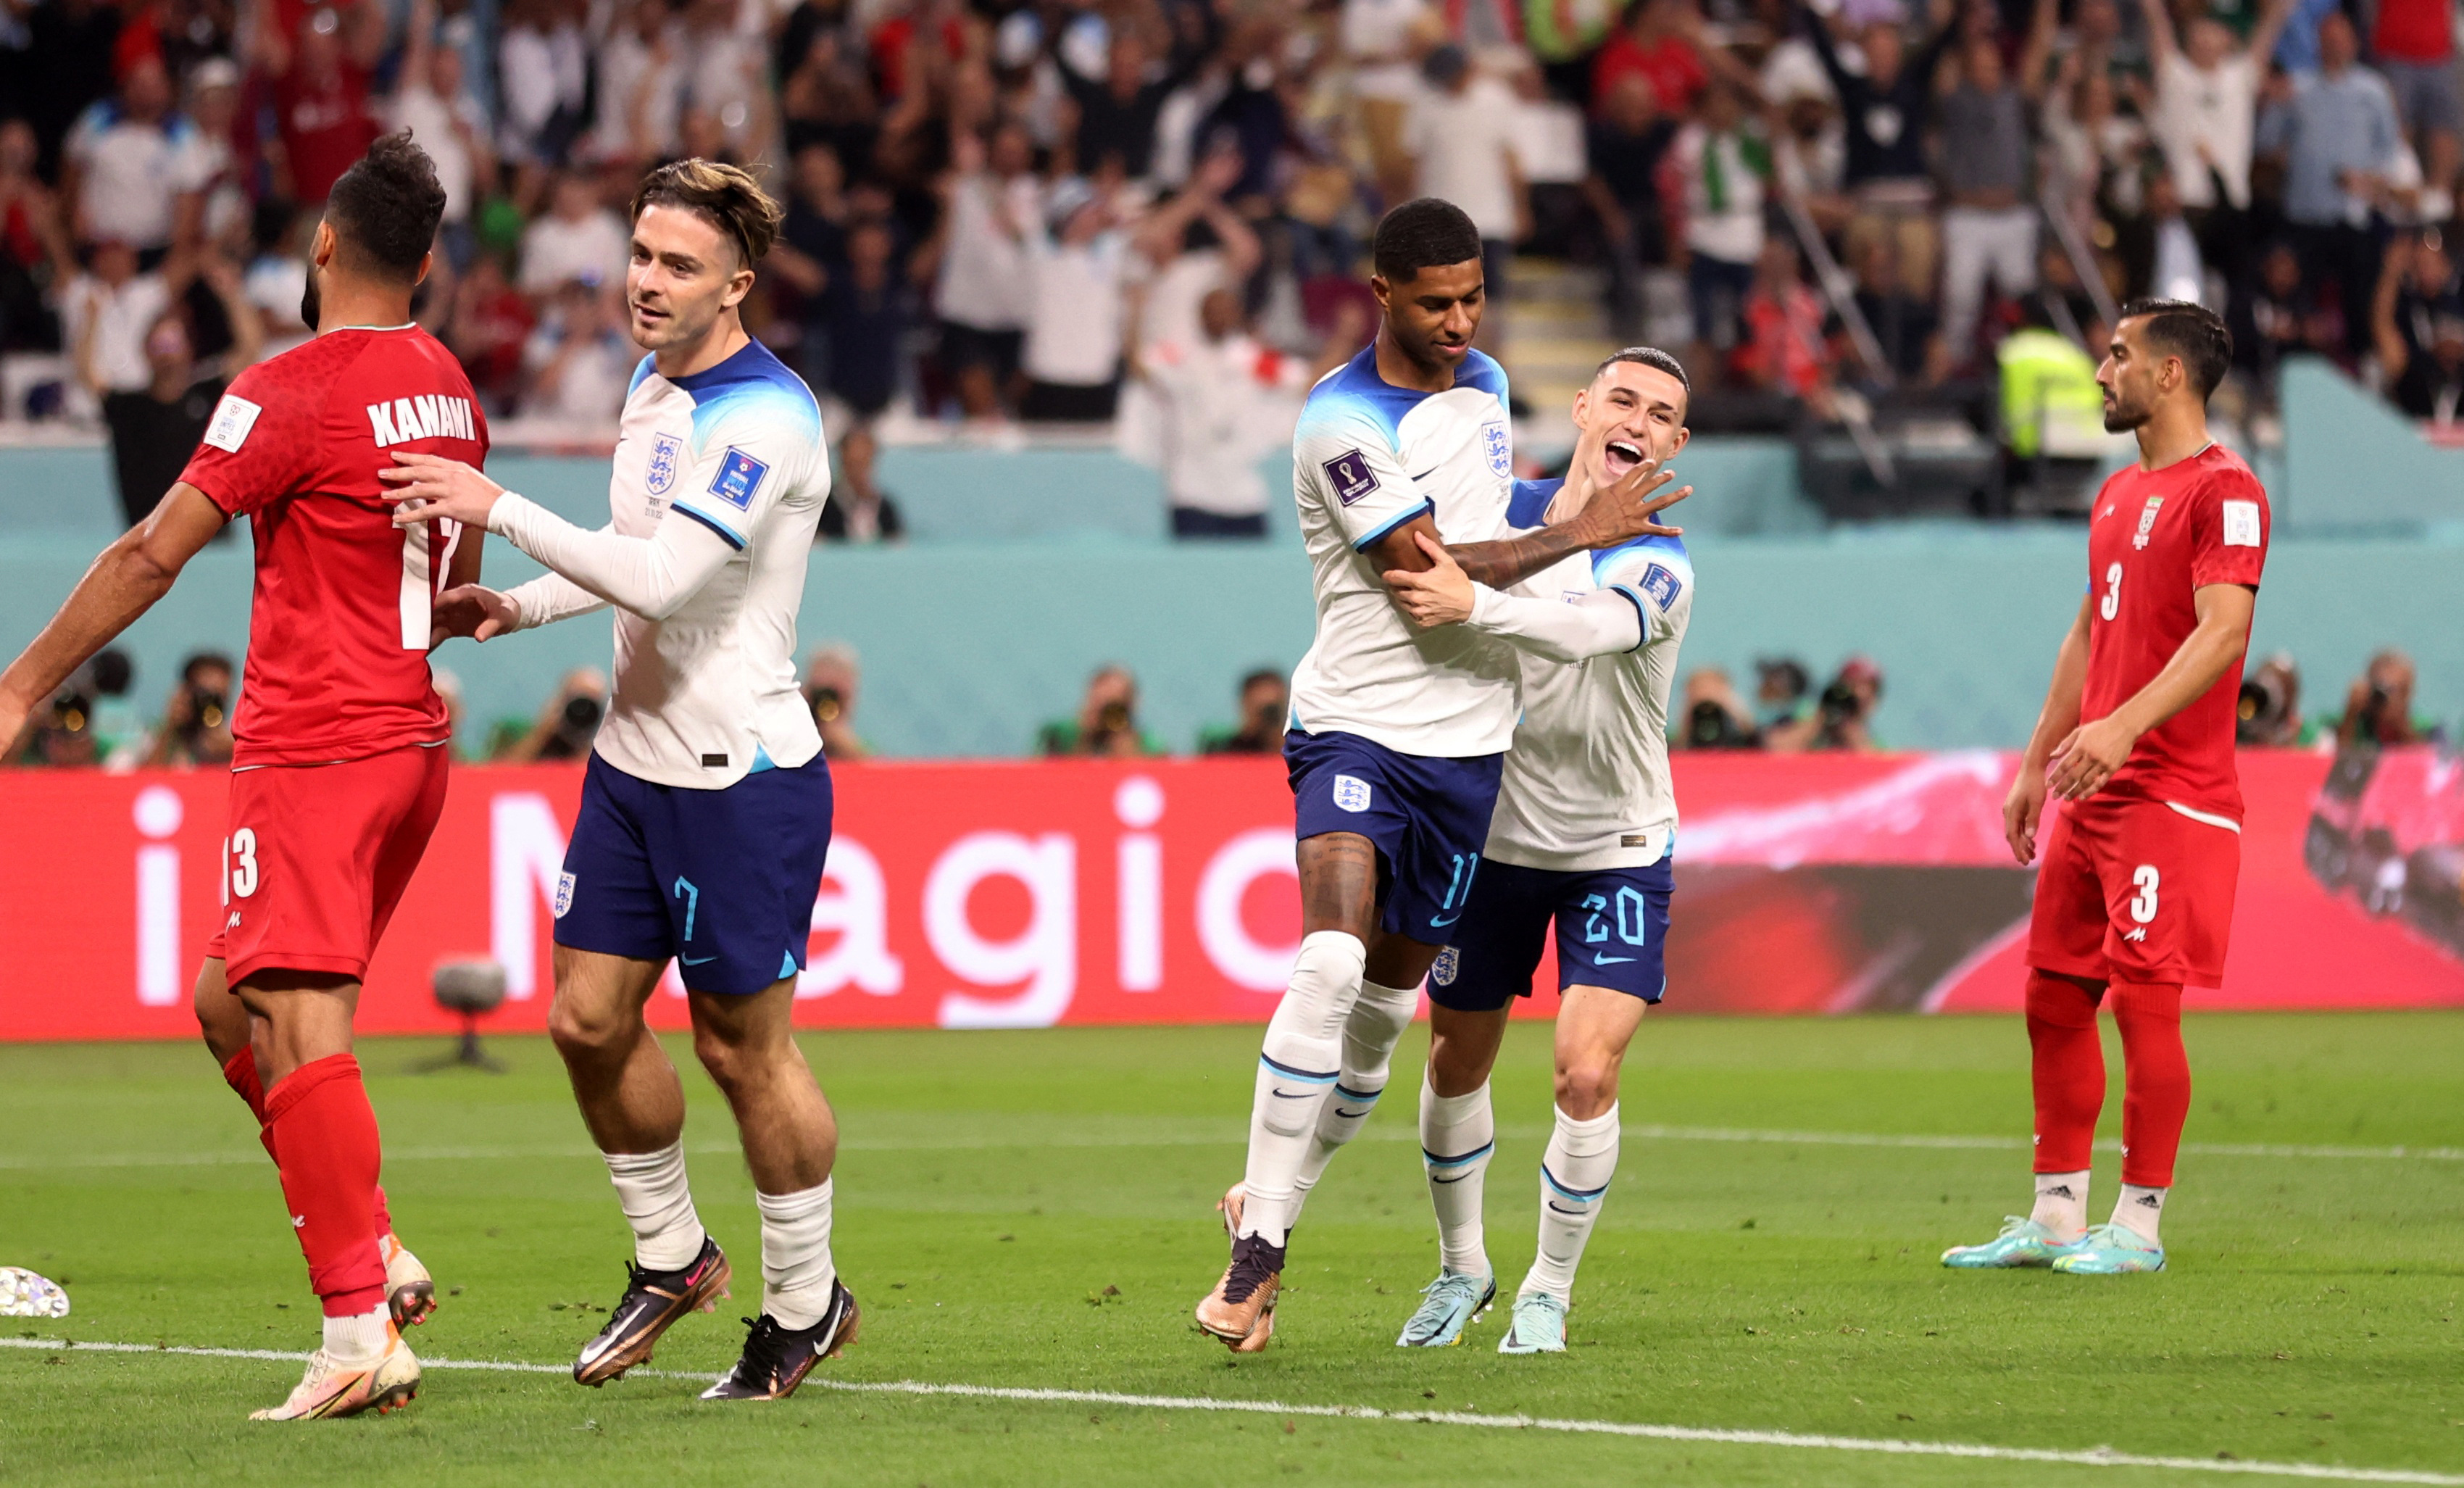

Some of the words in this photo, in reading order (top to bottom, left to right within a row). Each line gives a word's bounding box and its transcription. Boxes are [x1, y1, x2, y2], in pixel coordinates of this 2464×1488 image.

[367, 394, 475, 448] KANANI
[2101, 562, 2123, 622] 3
[675, 876, 698, 941] 7
[1443, 852, 1478, 909] 11
[2131, 864, 2159, 923] 3
[1581, 885, 1644, 947] 20
